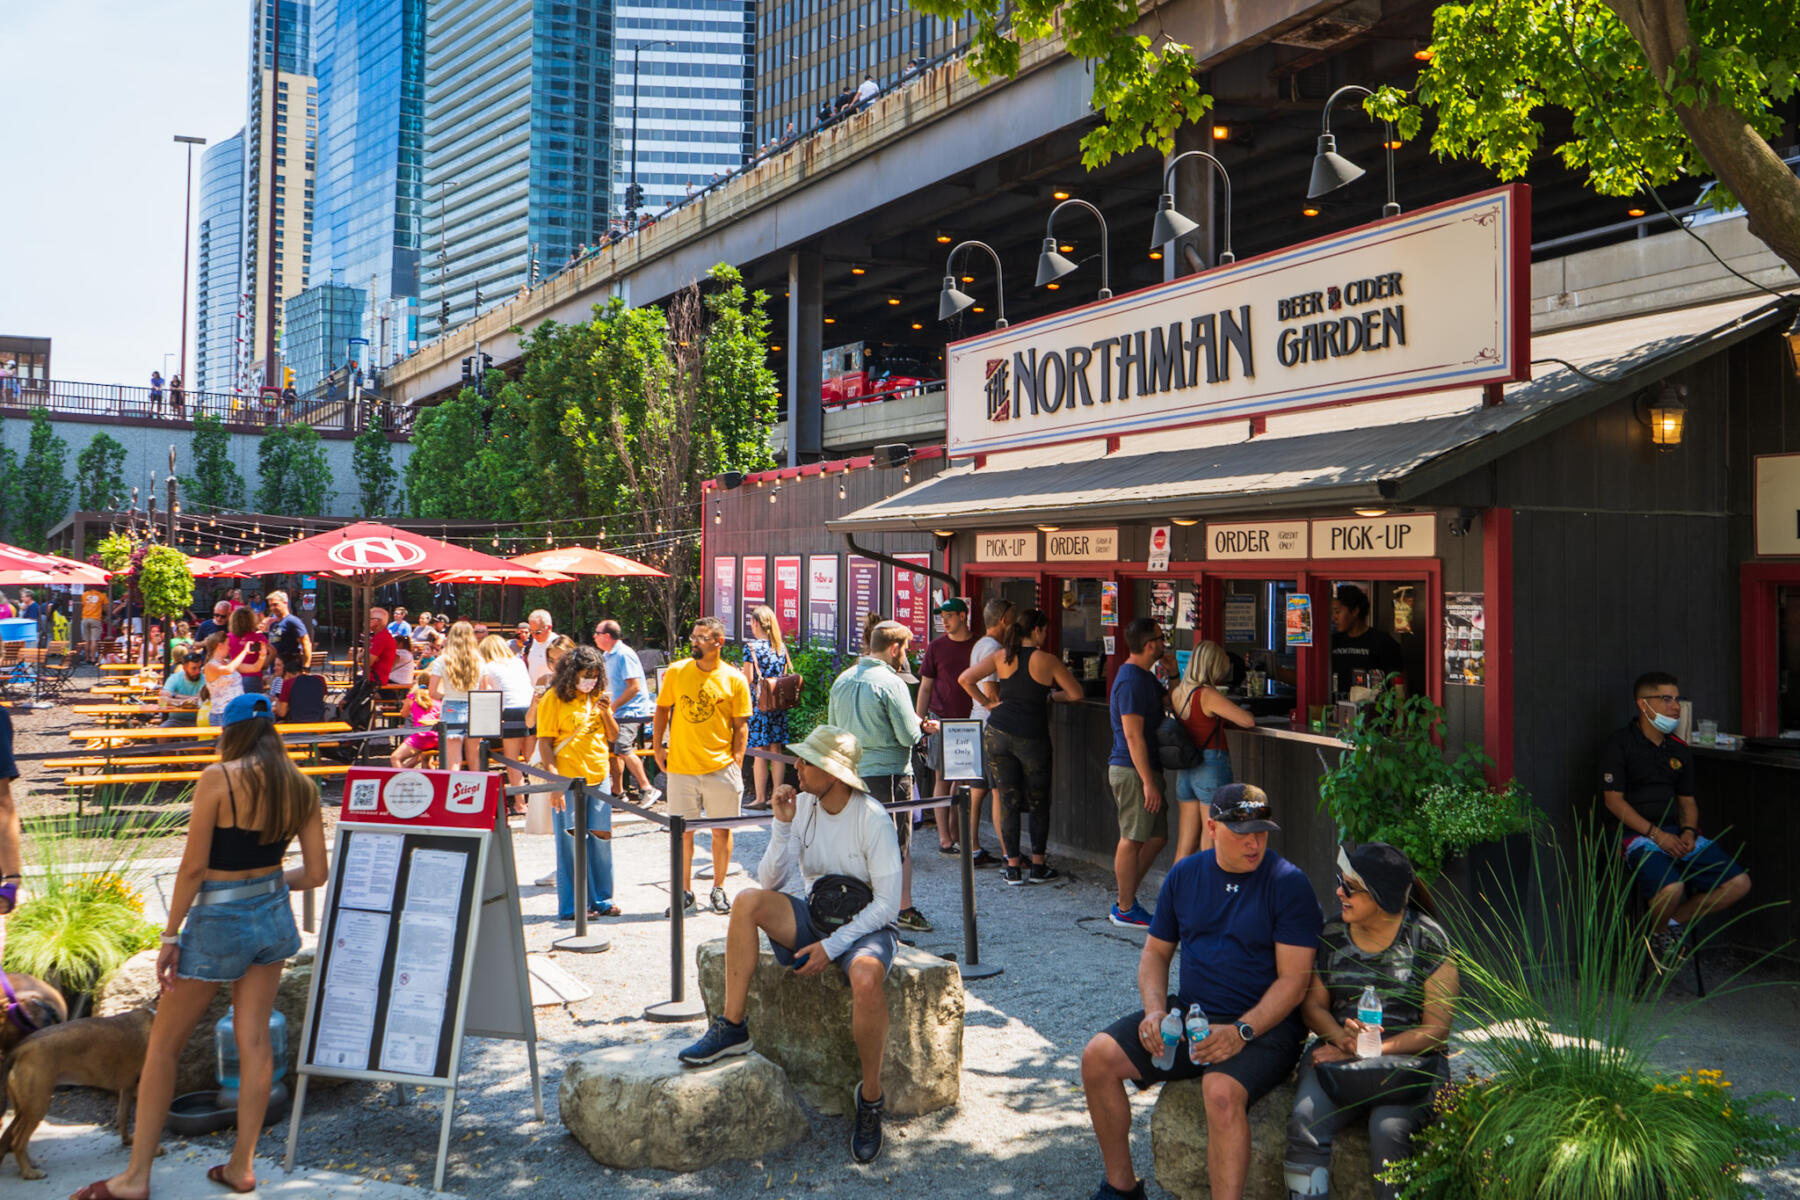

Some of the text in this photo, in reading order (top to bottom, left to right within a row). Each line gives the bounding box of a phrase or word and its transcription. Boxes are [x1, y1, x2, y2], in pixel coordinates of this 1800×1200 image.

[1278, 291, 1324, 322] BEER
[1343, 271, 1403, 306] CIDER
[1277, 305, 1406, 368] GARDEN
[984, 304, 1255, 421] THE NORTHMAN
[986, 538, 1027, 557] PICK-UP
[1050, 535, 1090, 556] ORDER
[1215, 529, 1270, 553] ORDER
[1330, 524, 1413, 551] PICK-UP
[452, 781, 481, 800] Stiegl
